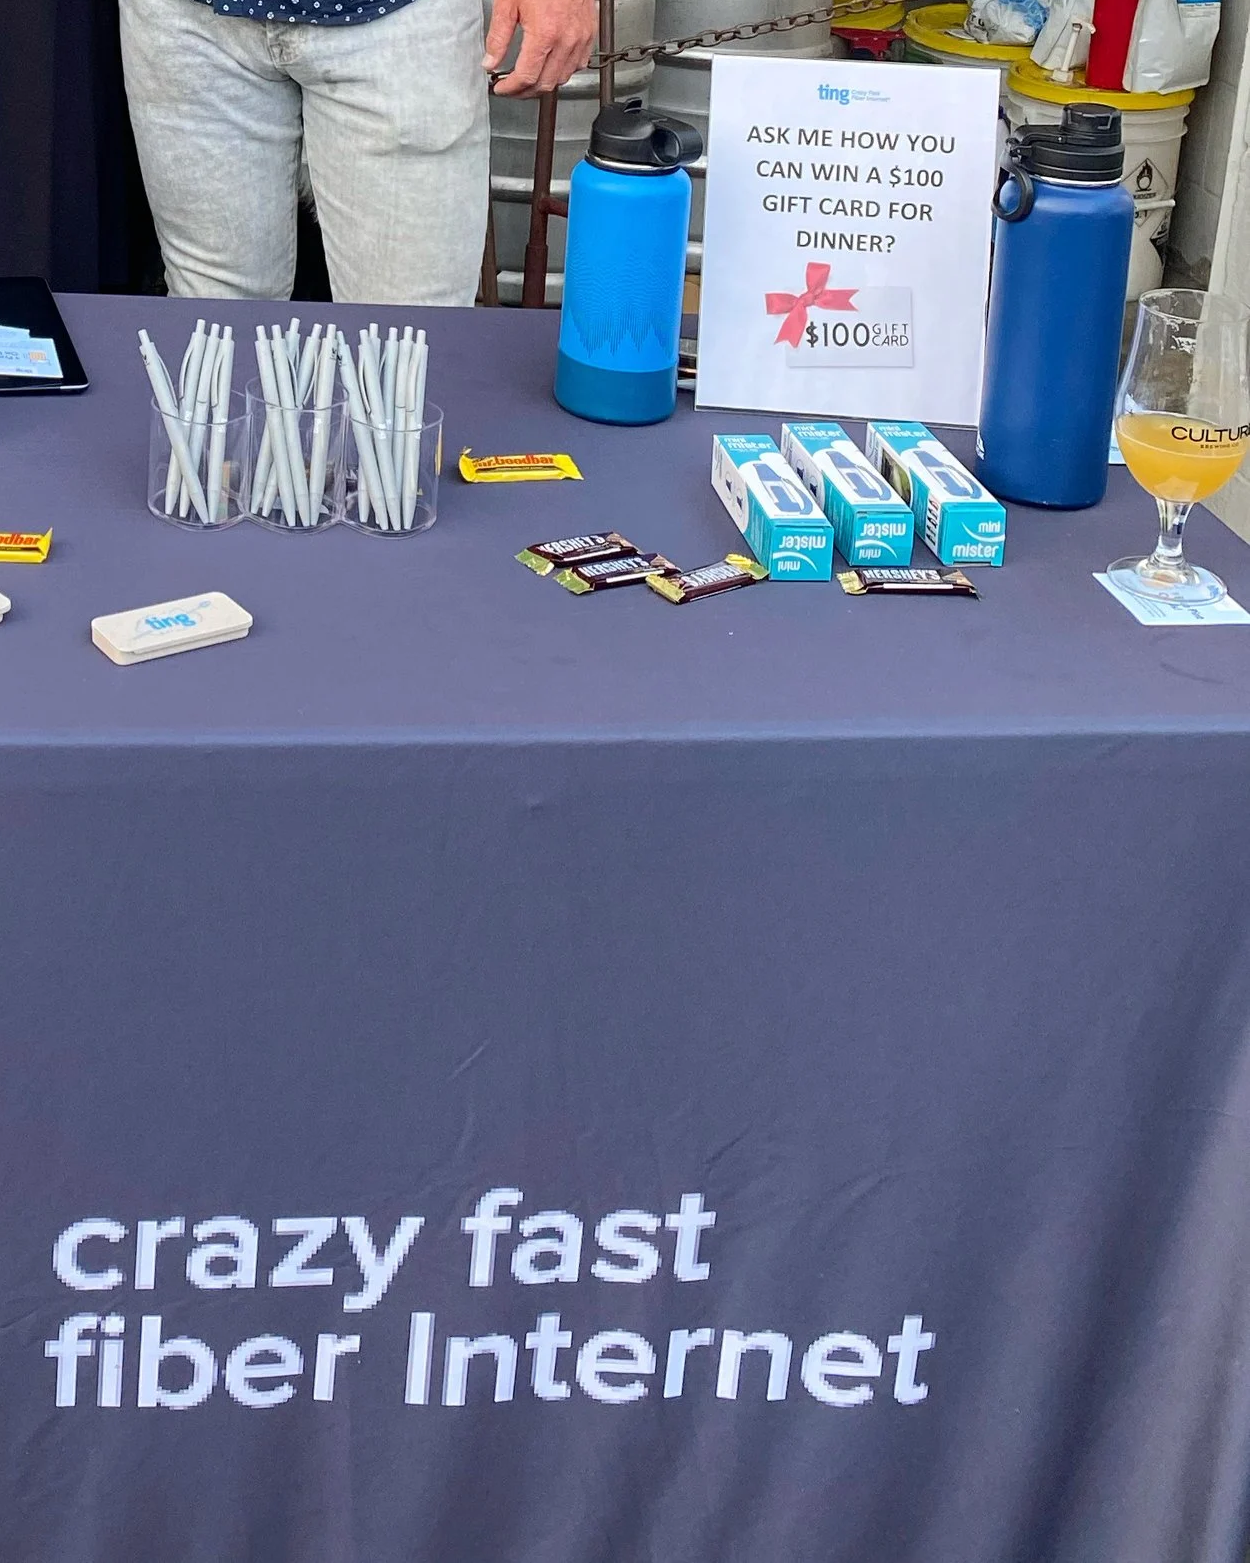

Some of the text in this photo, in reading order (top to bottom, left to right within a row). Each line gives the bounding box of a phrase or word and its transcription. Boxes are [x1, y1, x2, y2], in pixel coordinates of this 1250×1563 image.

[818, 84, 850, 105] ting
[747, 126, 955, 154] ASK ME HOW YOU
[756, 160, 944, 188] CAN WIN A $100
[762, 194, 933, 221] GIFT CARD FOR
[797, 230, 896, 253] DINNER?
[806, 321, 870, 348] $100
[872, 323, 909, 334] GIFT
[872, 335, 909, 347] CARD
[860, 523, 906, 537] mister
[979, 521, 1001, 533] mini
[779, 535, 826, 549] mister
[953, 543, 999, 557] mister
[859, 549, 881, 559] mini
[579, 556, 649, 577] HERSHEY'S
[778, 561, 800, 573] mini
[863, 569, 941, 580] HERSHEY'S
[145, 612, 196, 630] ting
[52, 1187, 717, 1313] crazy fast
[44, 1311, 938, 1411] fiber Internet
